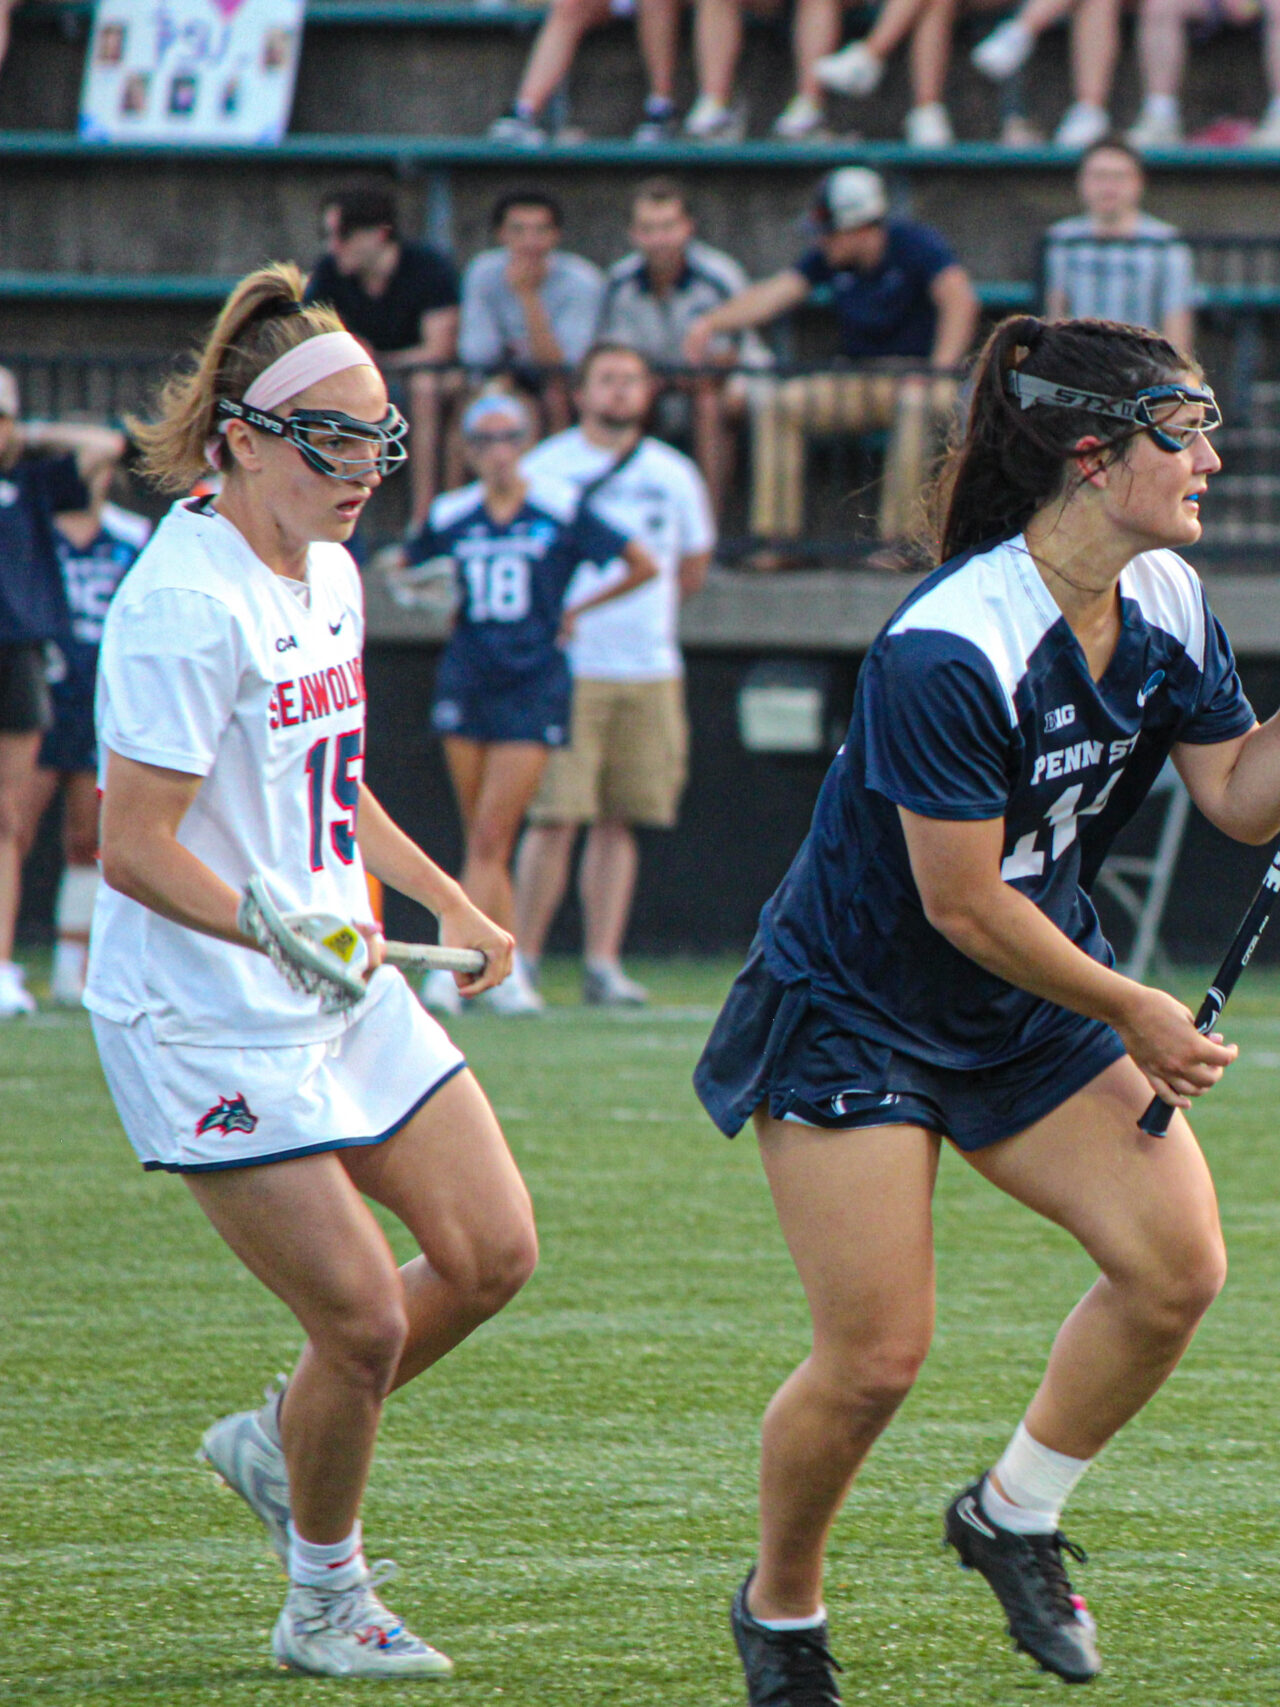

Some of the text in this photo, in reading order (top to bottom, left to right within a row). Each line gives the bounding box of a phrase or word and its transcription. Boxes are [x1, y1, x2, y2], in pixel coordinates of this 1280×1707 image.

[1055, 387, 1116, 414] STX
[463, 554, 532, 623] 18
[1030, 739, 1105, 786] PENN
[304, 727, 366, 873] 15
